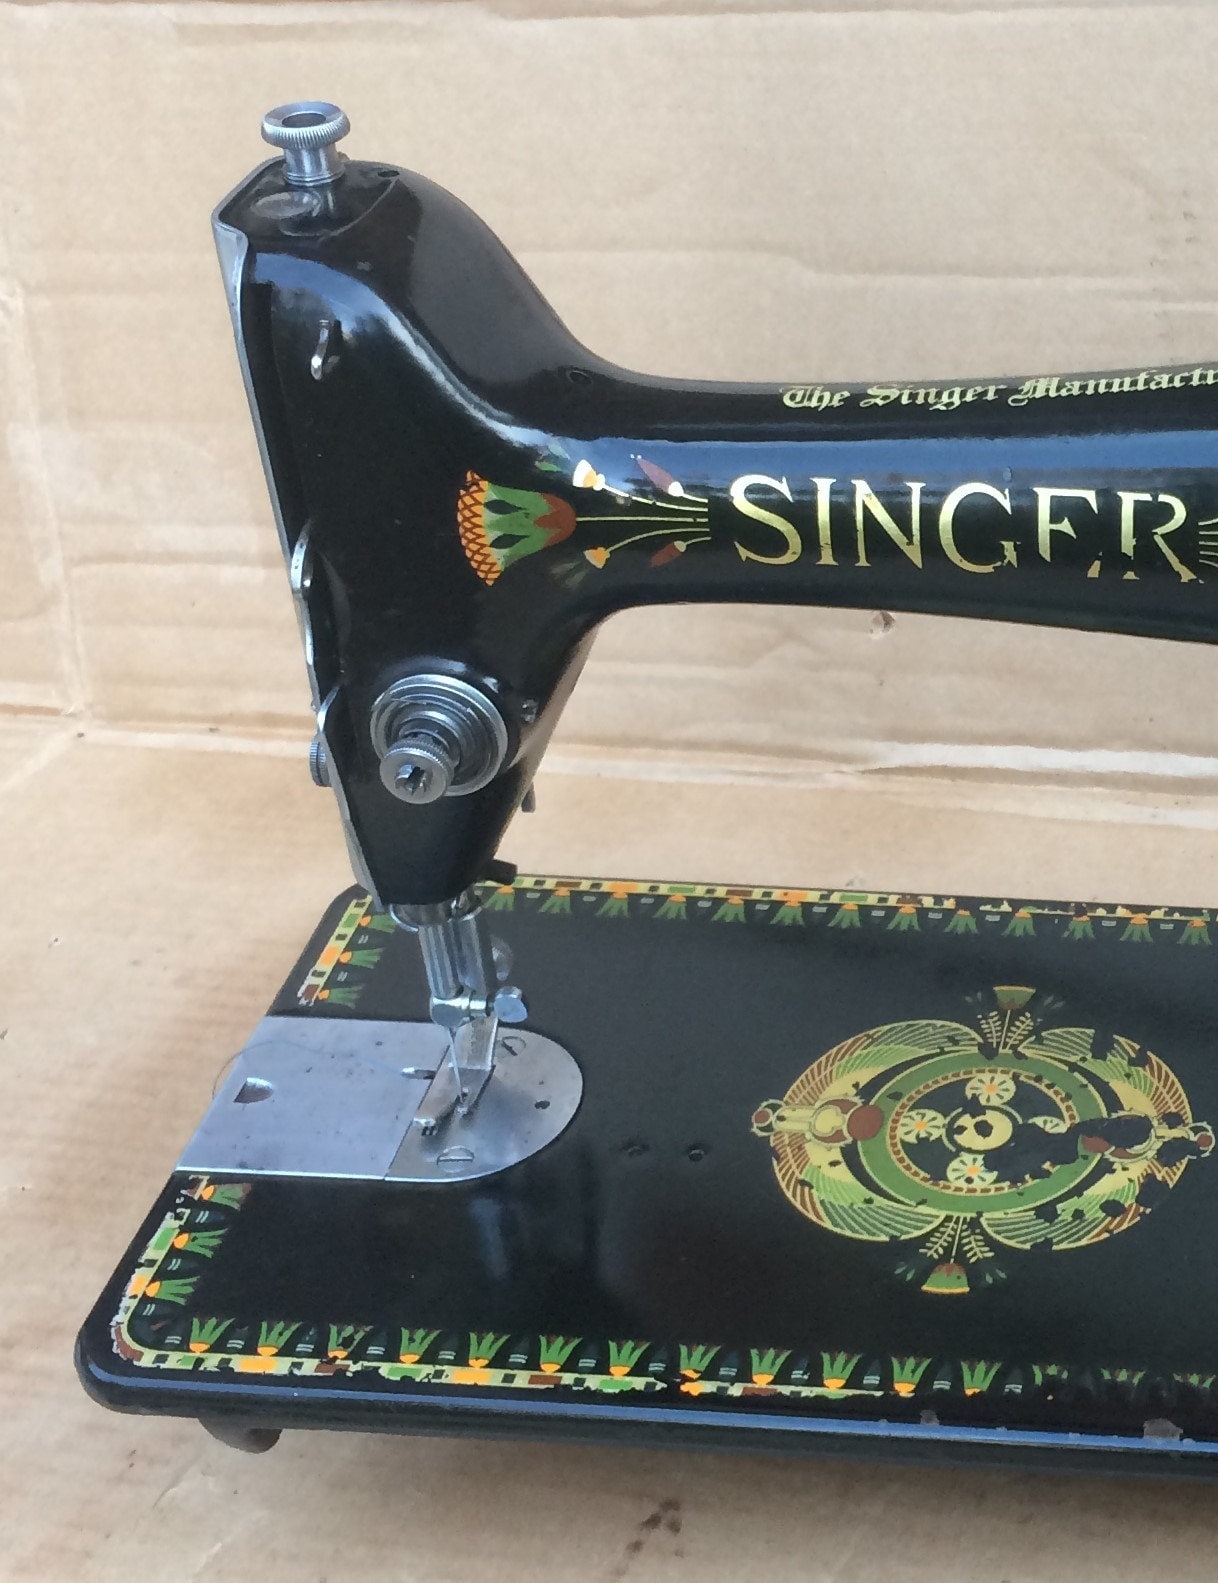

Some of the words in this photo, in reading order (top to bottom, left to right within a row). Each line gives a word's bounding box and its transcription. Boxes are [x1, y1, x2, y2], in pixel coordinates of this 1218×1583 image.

[783, 386, 851, 411] The
[859, 384, 1007, 411] Singer
[730, 474, 1200, 583] SINGER
